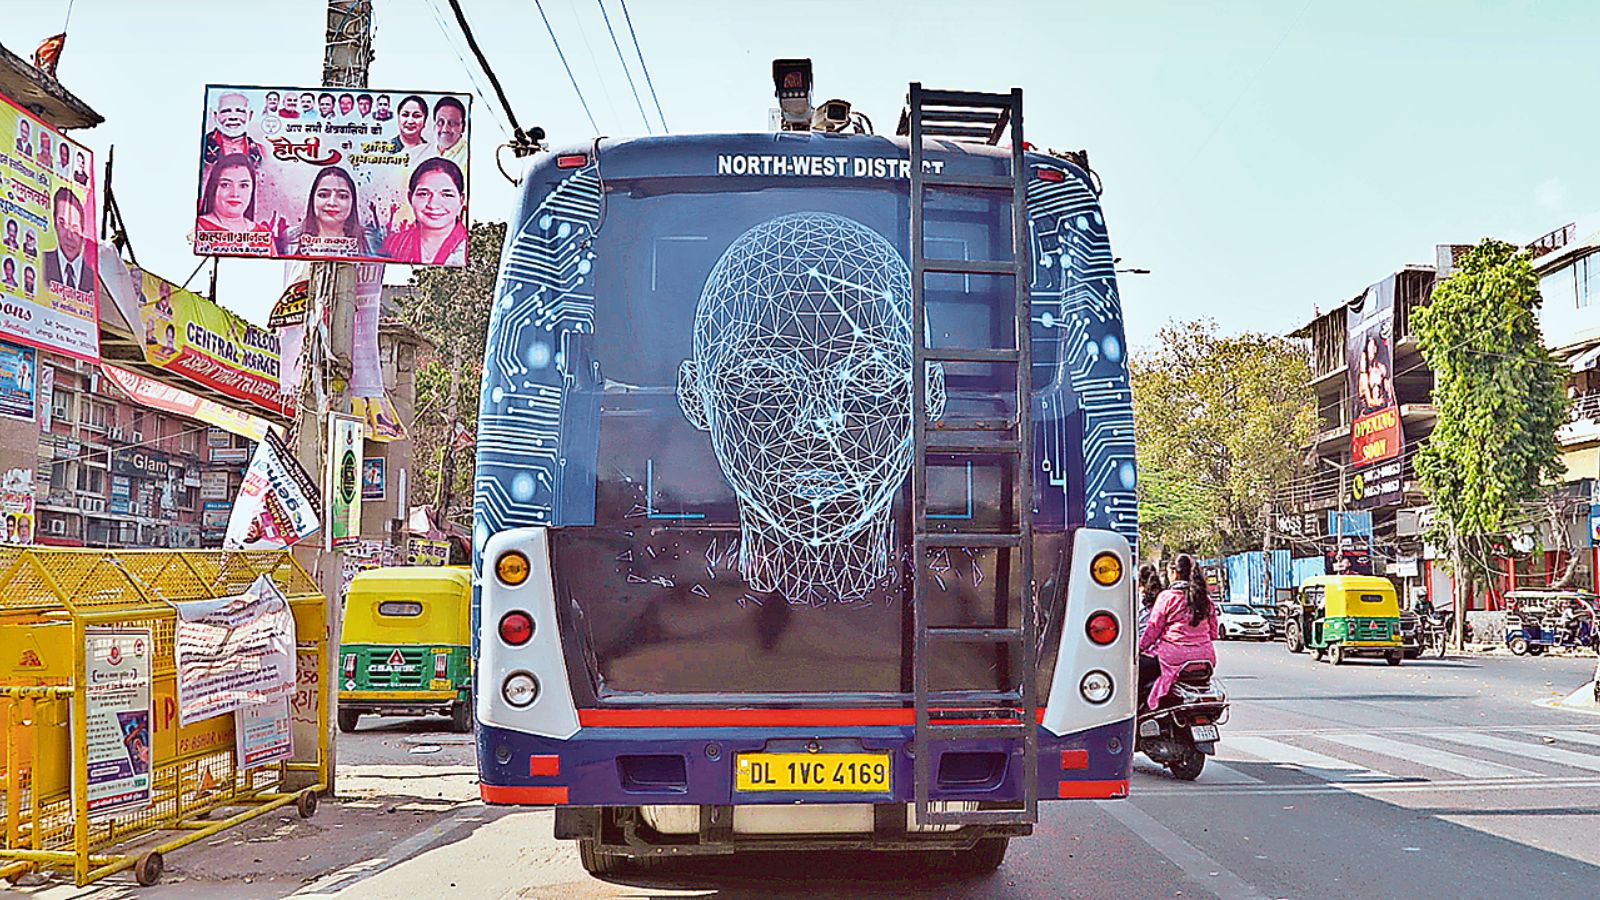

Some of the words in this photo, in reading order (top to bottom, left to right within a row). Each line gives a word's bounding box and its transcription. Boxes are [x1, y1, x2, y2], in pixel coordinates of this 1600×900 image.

[286, 122, 302, 133] आप
[370, 122, 383, 135] को
[265, 136, 343, 166] होली
[718, 155, 848, 176] NORTH-WEST
[854, 157, 944, 178] DISTRCT
[199, 232, 234, 244] कल्पना
[187, 321, 239, 363] CENTRAL
[1354, 410, 1396, 438] OPENING
[133, 454, 168, 473] Glam
[751, 762, 776, 785] DL
[788, 762, 825, 785] 1VC
[832, 762, 885, 785] 4169
